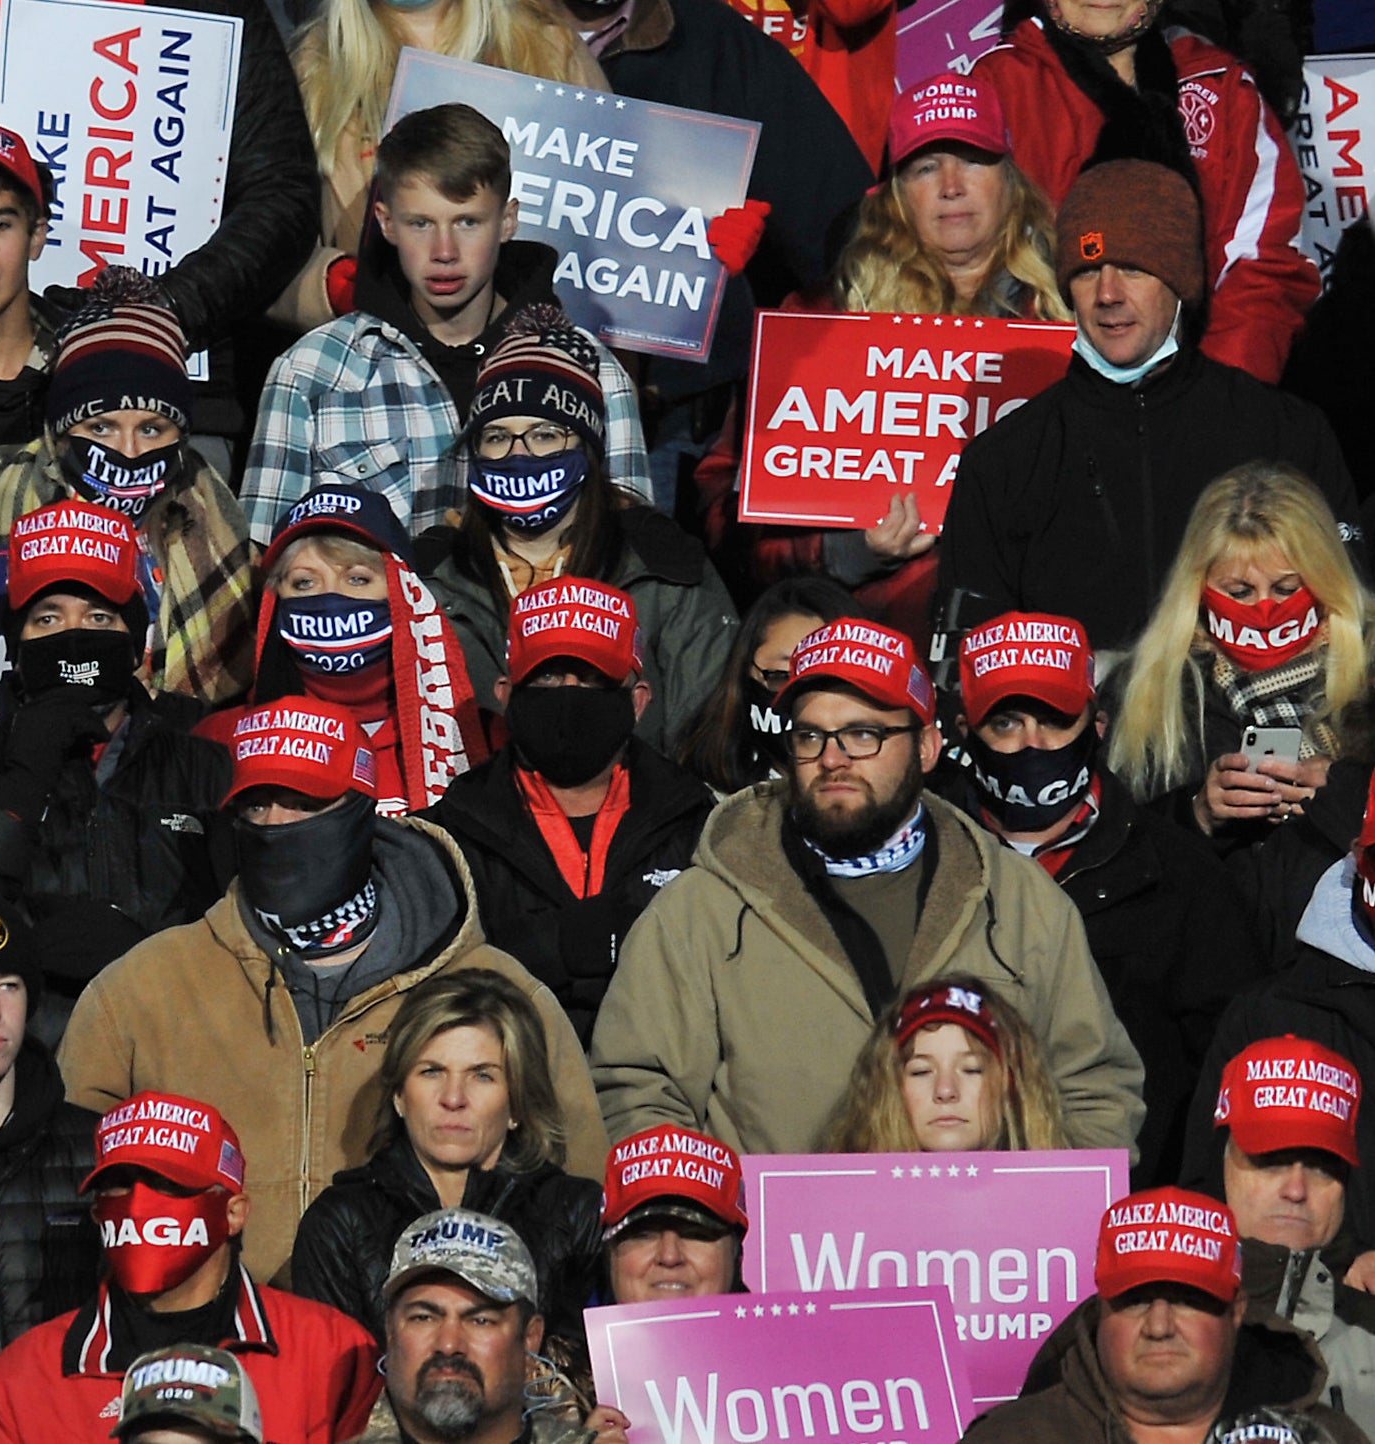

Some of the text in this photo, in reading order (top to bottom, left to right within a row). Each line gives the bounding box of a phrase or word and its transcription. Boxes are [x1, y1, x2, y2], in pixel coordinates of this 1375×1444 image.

[913, 83, 977, 102] WOMEN
[932, 97, 956, 106] FOR
[913, 109, 977, 126] TRUMP
[77, 27, 142, 288] MERICA
[142, 29, 192, 277] EAT AGAIN
[502, 116, 638, 177] MAKE
[509, 171, 712, 259] ERICA
[553, 252, 706, 311] AGAIN
[866, 346, 1004, 383] MAKE
[766, 386, 1031, 439] AMERI
[87, 444, 166, 497] Trump
[763, 445, 925, 484] GREAT
[482, 468, 566, 497] TRUMP
[289, 493, 361, 524] Trump
[15, 509, 129, 542] MAKE AMERICA
[20, 534, 120, 565] GREAT AGAIN
[516, 585, 630, 618] MAKE AMERICA
[290, 610, 374, 638] TRUMP
[522, 610, 621, 640] GREAT AGAIN
[964, 622, 1080, 655] MAKE AMERICA
[1208, 606, 1318, 650] MAGA
[794, 625, 905, 658] MAKE AMERICA
[58, 660, 99, 674] Trump
[796, 647, 893, 676] GREAT AGAIN
[974, 650, 1071, 676] GREAT AGAIN
[233, 709, 346, 741] MAKE AMERICA
[236, 736, 332, 765] GREAT AGAIN
[975, 763, 1090, 806] MAGA
[946, 987, 981, 1015] N
[1247, 1059, 1358, 1099] MAKE AMERICA
[100, 1099, 210, 1133] MAKE AMERICA
[1254, 1086, 1350, 1122] GREAT AGAIN
[102, 1126, 198, 1155] GREAT AGAIN
[614, 1133, 733, 1168] MAKE AMERICA
[622, 1161, 725, 1190] GREAT AGAIN
[100, 1217, 209, 1248] MAGA
[411, 1223, 505, 1248] TRUMP
[1108, 1202, 1231, 1237] MAKE AMERICA
[1115, 1230, 1222, 1261] GREAT AGAIN
[790, 1232, 1077, 1304] Women
[956, 1313, 1052, 1341] RUMP
[132, 1358, 231, 1391] TRUMP
[156, 1388, 193, 1400] 2020
[644, 1372, 930, 1444] Women
